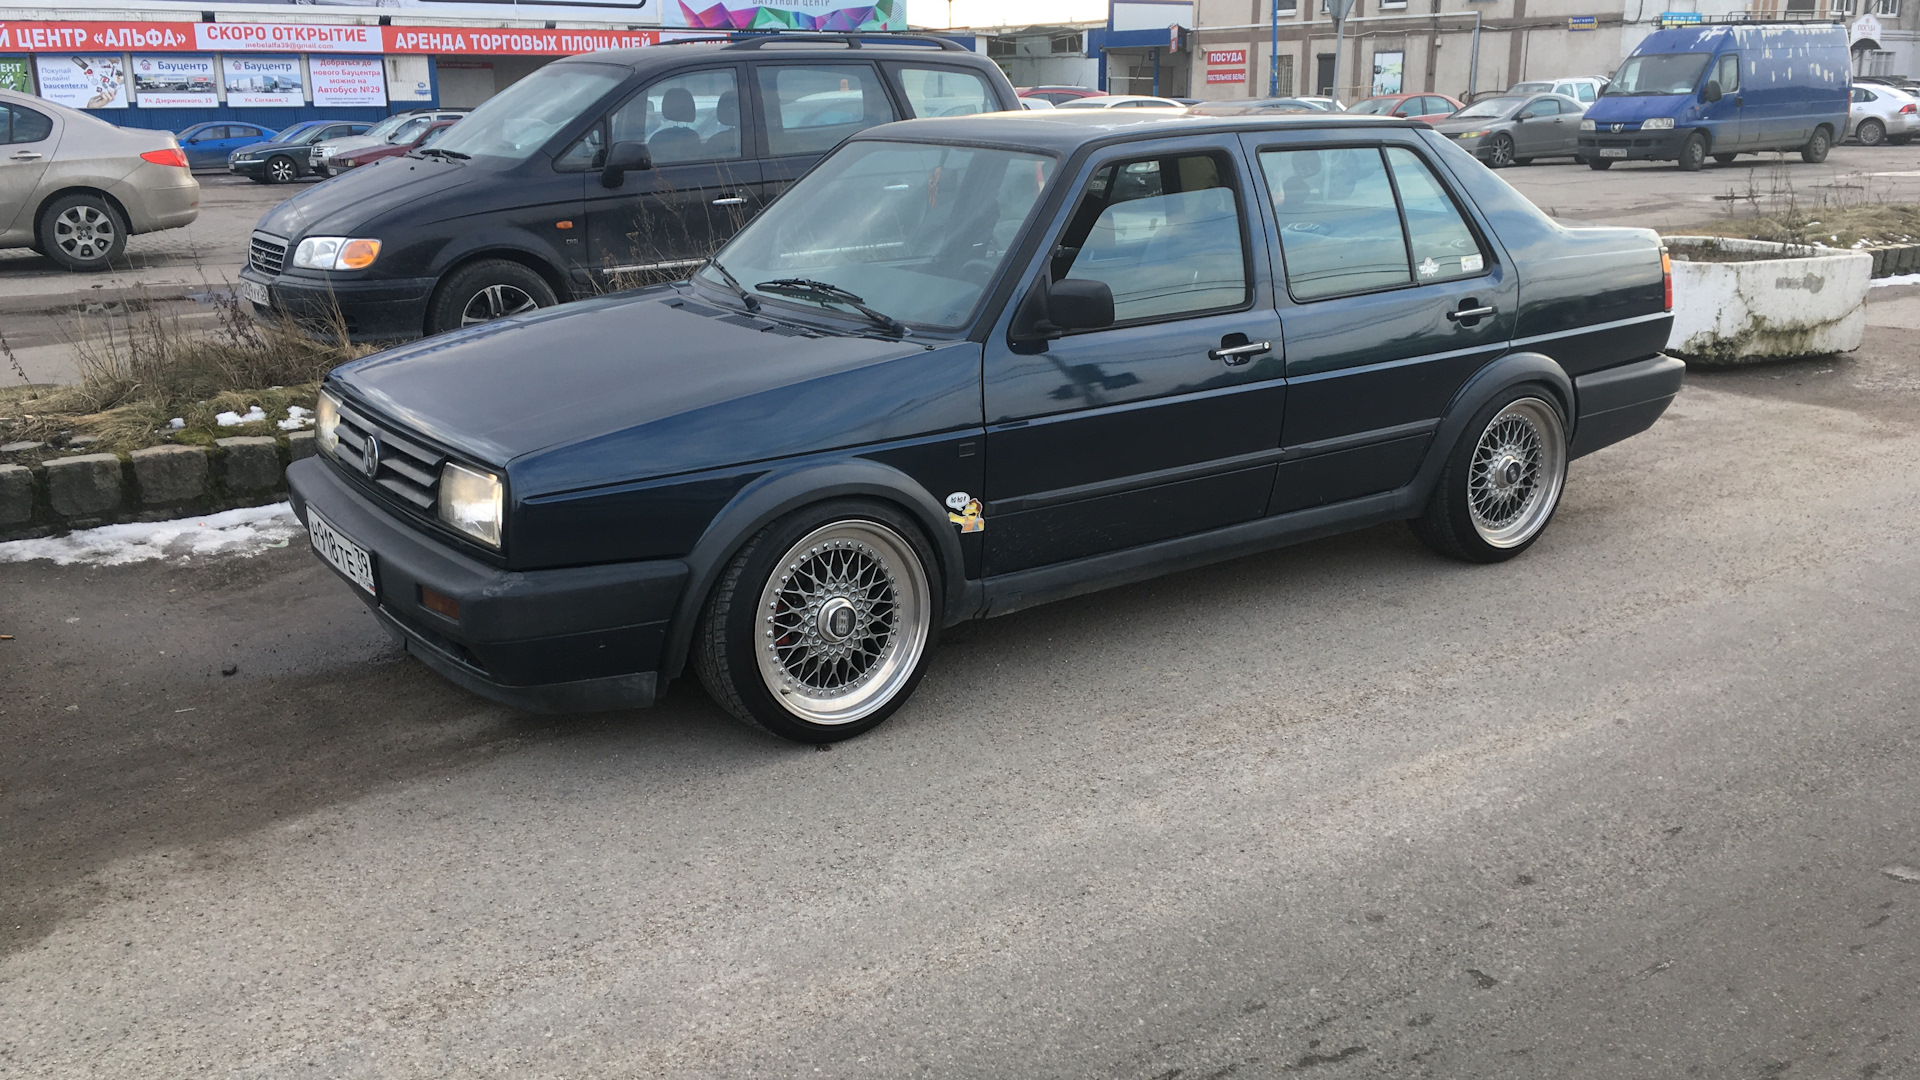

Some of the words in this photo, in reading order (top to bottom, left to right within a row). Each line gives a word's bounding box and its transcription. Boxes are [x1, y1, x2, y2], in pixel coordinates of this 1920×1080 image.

[16, 28, 87, 50] ЦЕНТР
[93, 28, 187, 48] «АЛЬФА»
[206, 25, 267, 41] СКОРО
[272, 27, 367, 43] ОТКРЫТИЕ
[245, 42, 334, 50] mebelalfa39@gmail.com
[395, 32, 466, 51] АРЕНДА
[470, 34, 558, 51] ТОРГОВЫХ
[561, 33, 651, 51] ПЛОЩАДЕЙ
[1210, 52, 1243, 62] ПОСУДА
[157, 61, 208, 72] Бауцентр
[244, 61, 292, 72] Бауцентр
[320, 58, 361, 67] Добраться
[41, 67, 71, 75] Покупай
[341, 69, 381, 77] Бауцентра
[317, 86, 358, 95] Автобусе
